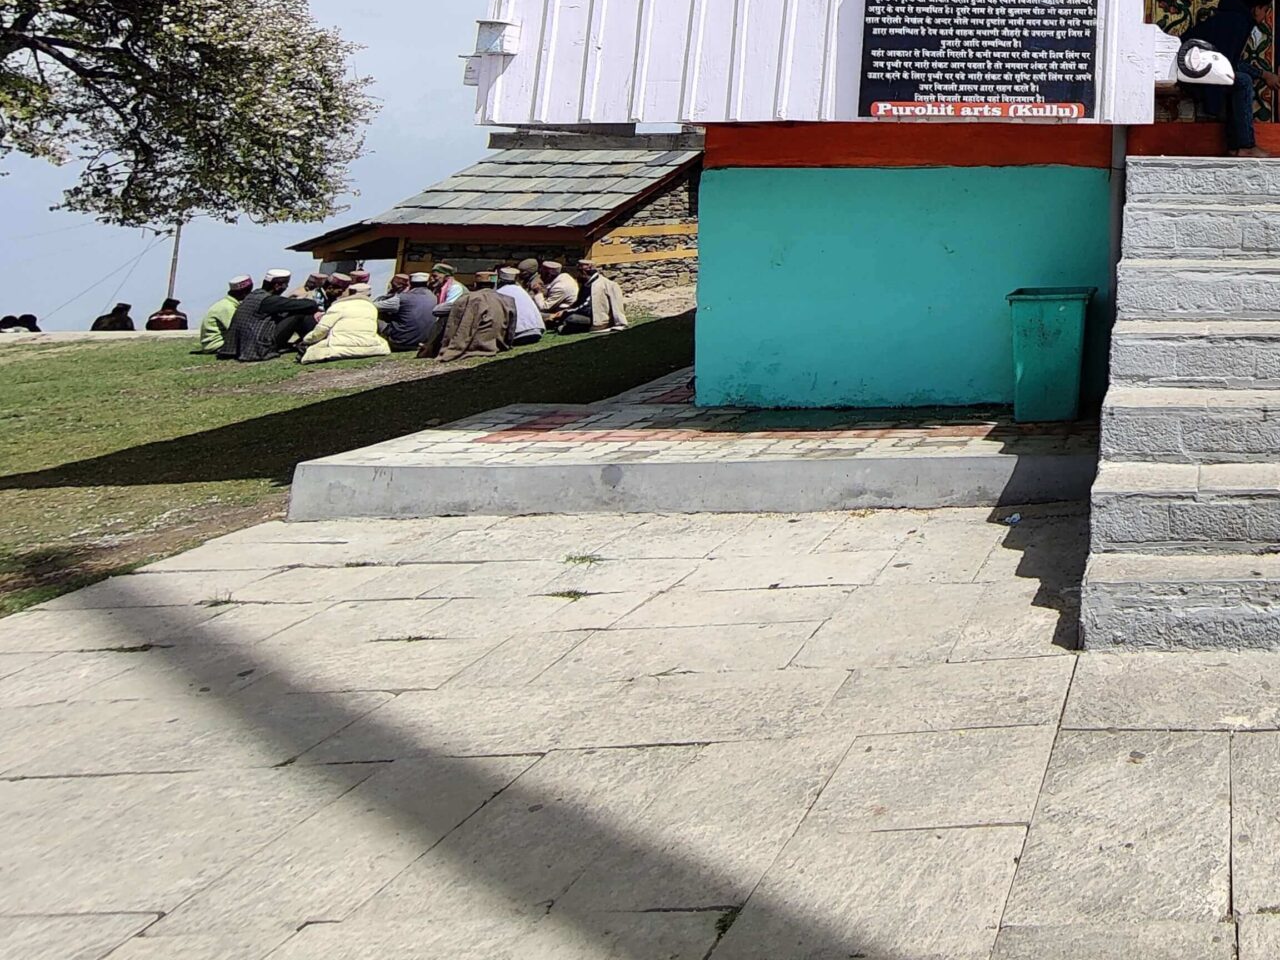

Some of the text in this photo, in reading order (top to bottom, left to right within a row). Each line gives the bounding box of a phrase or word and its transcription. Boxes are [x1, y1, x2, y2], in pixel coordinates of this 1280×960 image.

[877, 103, 1079, 118] Purohit arts (Kullu)
